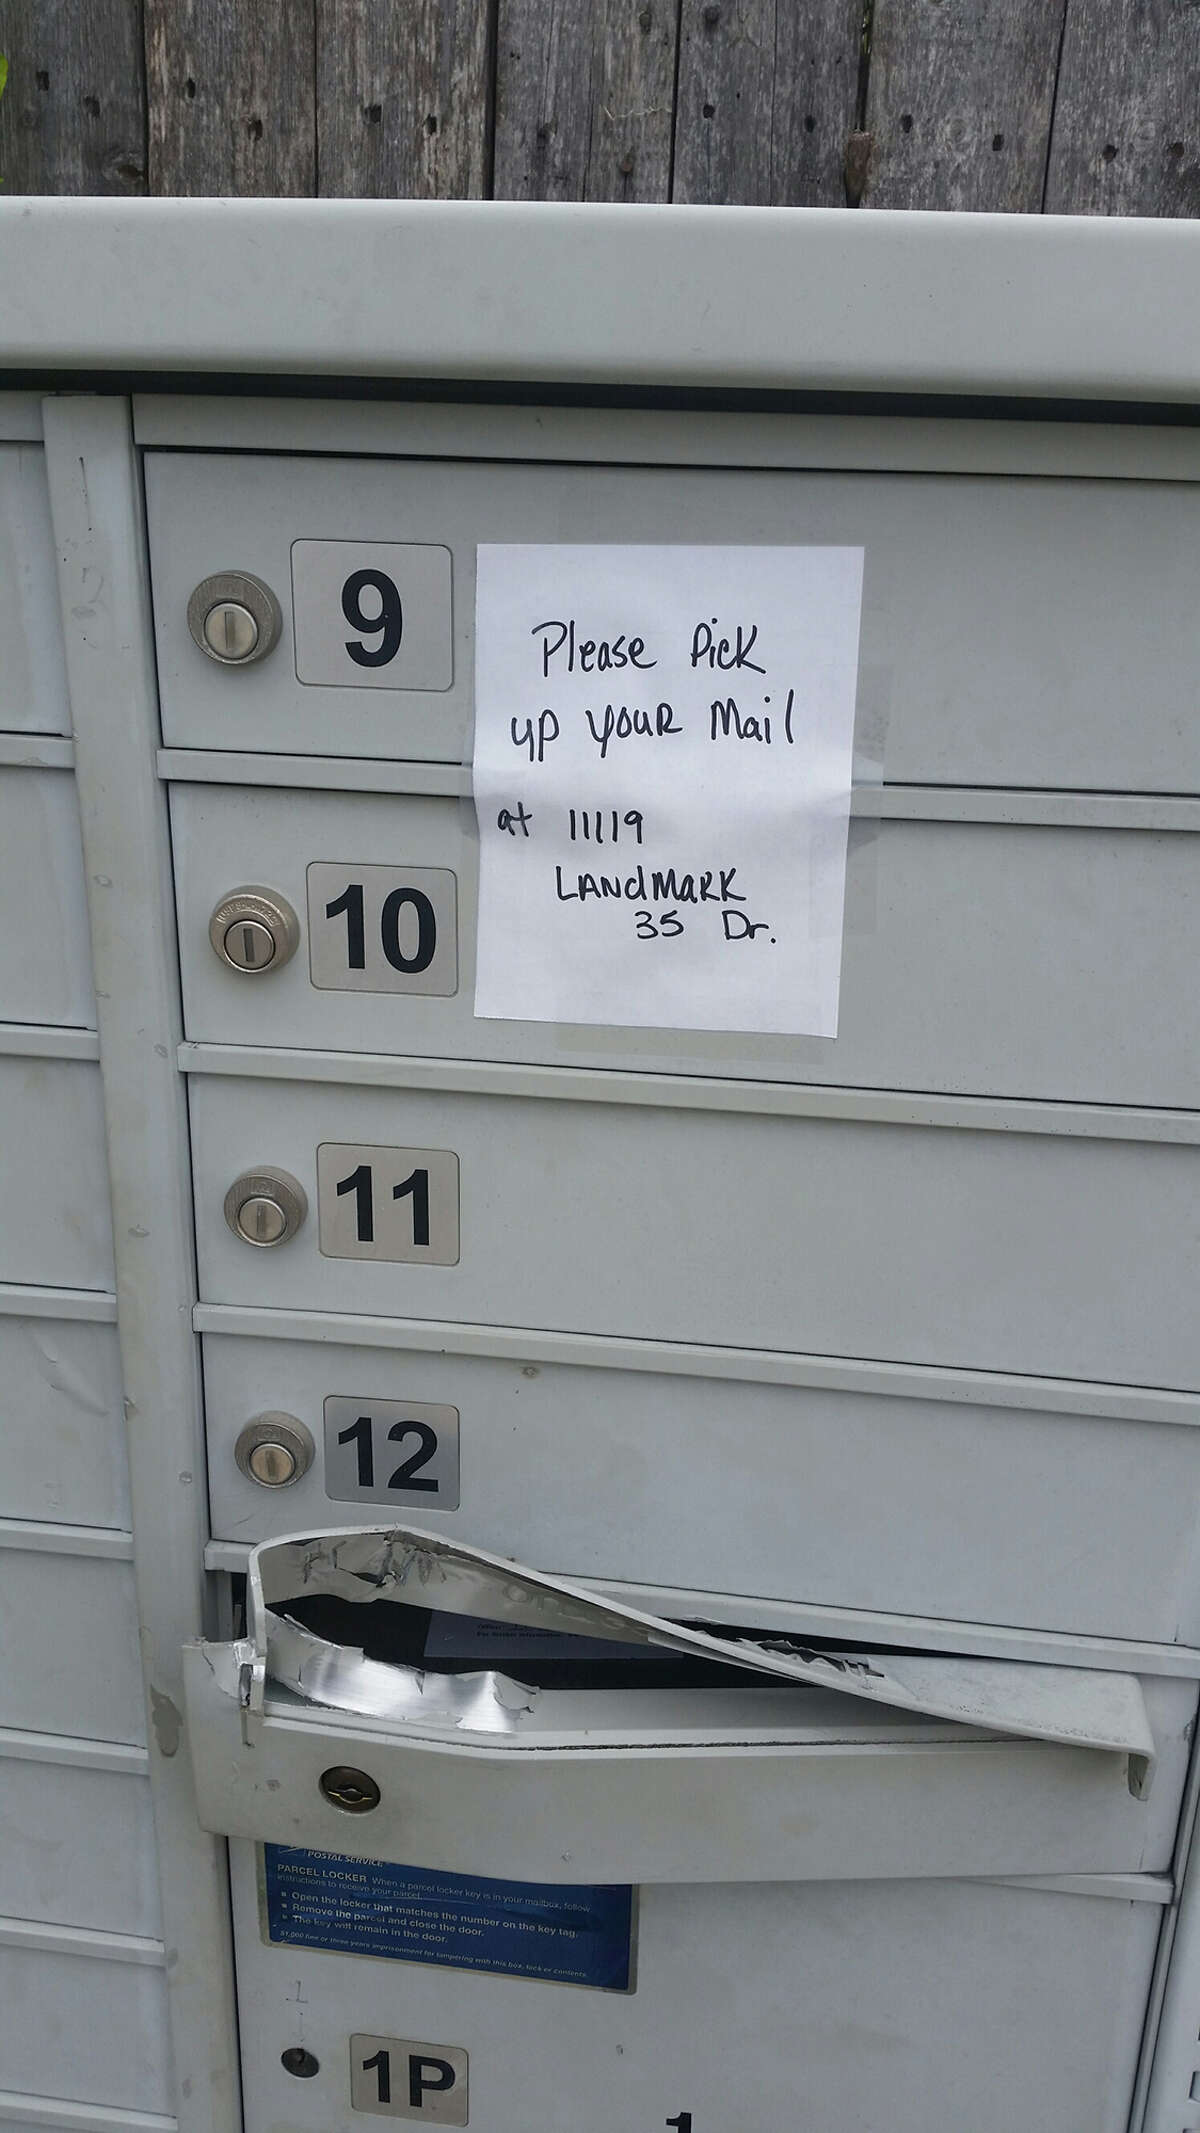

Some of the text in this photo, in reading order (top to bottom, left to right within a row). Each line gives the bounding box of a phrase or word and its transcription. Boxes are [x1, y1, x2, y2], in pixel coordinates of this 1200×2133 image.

[342, 569, 402, 668] 9
[531, 620, 658, 677] Please
[511, 709, 560, 762] up
[710, 689, 795, 744] Mail
[497, 801, 644, 844] at 11119
[326, 884, 436, 974] 10
[635, 910, 777, 944] 35 Dr.
[336, 1165, 430, 1246] 11
[338, 1417, 439, 1492] 12
[307, 1850, 342, 1862] POSTAL
[277, 1864, 320, 1877] PARCEL
[322, 1871, 367, 1883] LOCKER
[372, 1876, 398, 1888] When
[400, 1881, 406, 1889] a
[408, 1882, 435, 1893] parcel
[437, 1885, 464, 1895] locker
[465, 1888, 481, 1900] key
[502, 1895, 523, 1905] your
[277, 1872, 326, 1886] instructions
[371, 1886, 392, 1897] your
[291, 1891, 319, 1903] Open
[321, 1895, 337, 1905] the
[339, 1898, 371, 1910] locker
[373, 1903, 393, 1913] that
[396, 1906, 439, 1919] matches
[441, 1911, 458, 1921] the
[460, 1914, 500, 1927] number
[502, 1920, 516, 1929] on
[519, 1922, 536, 1932] the
[538, 1924, 556, 1936] key
[291, 1903, 485, 1937] Remove the parcel and close the door.
[292, 1914, 448, 1943] The key will remain in the door.
[362, 2050, 456, 2108] 1P
